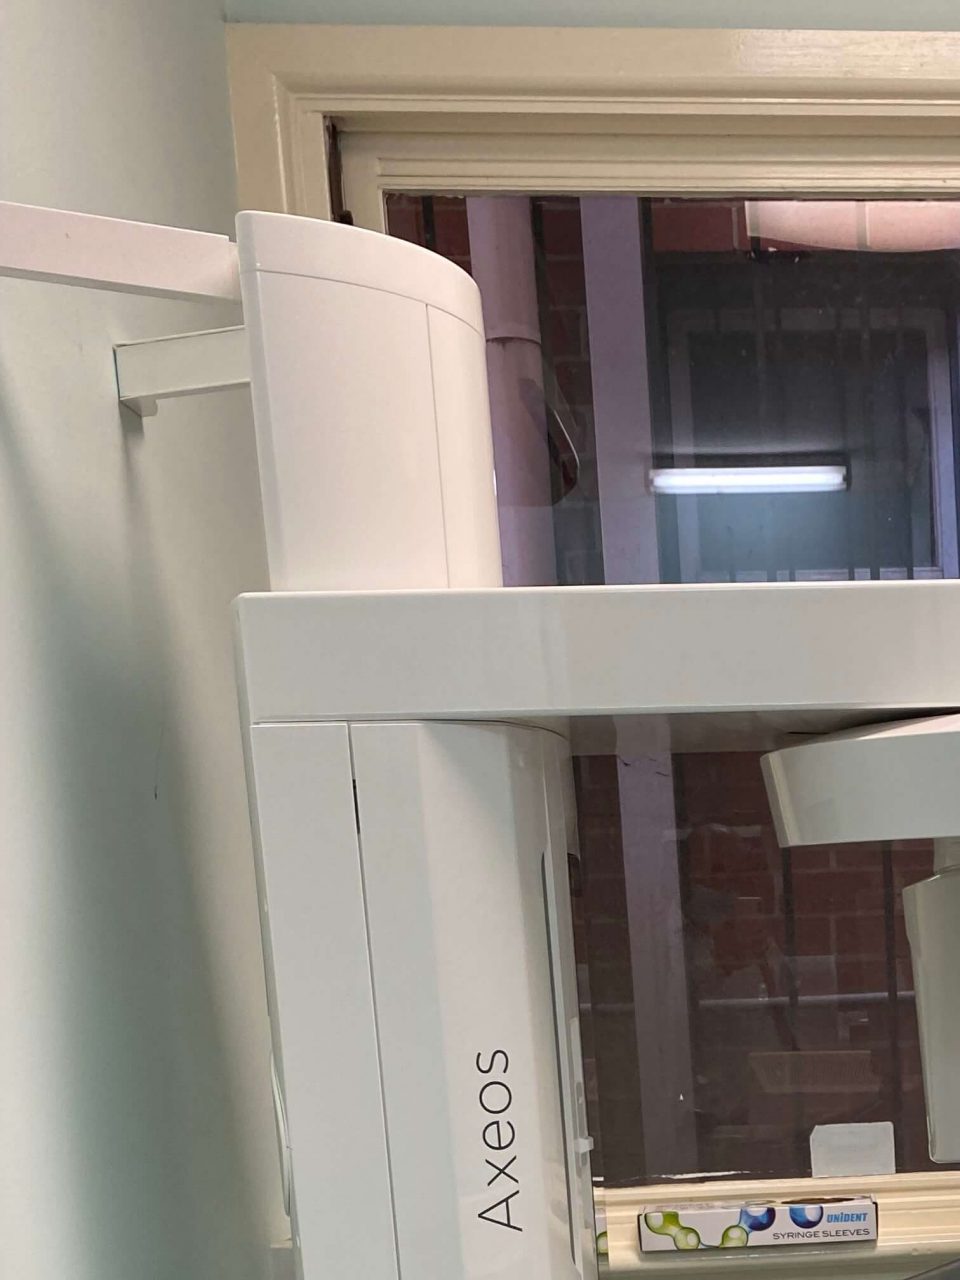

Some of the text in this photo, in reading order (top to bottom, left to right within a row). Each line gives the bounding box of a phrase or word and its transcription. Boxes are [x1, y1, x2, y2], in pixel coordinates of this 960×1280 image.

[476, 1049, 523, 1232] Axeos
[773, 1228, 870, 1240] SYRINGE SLEEVES
